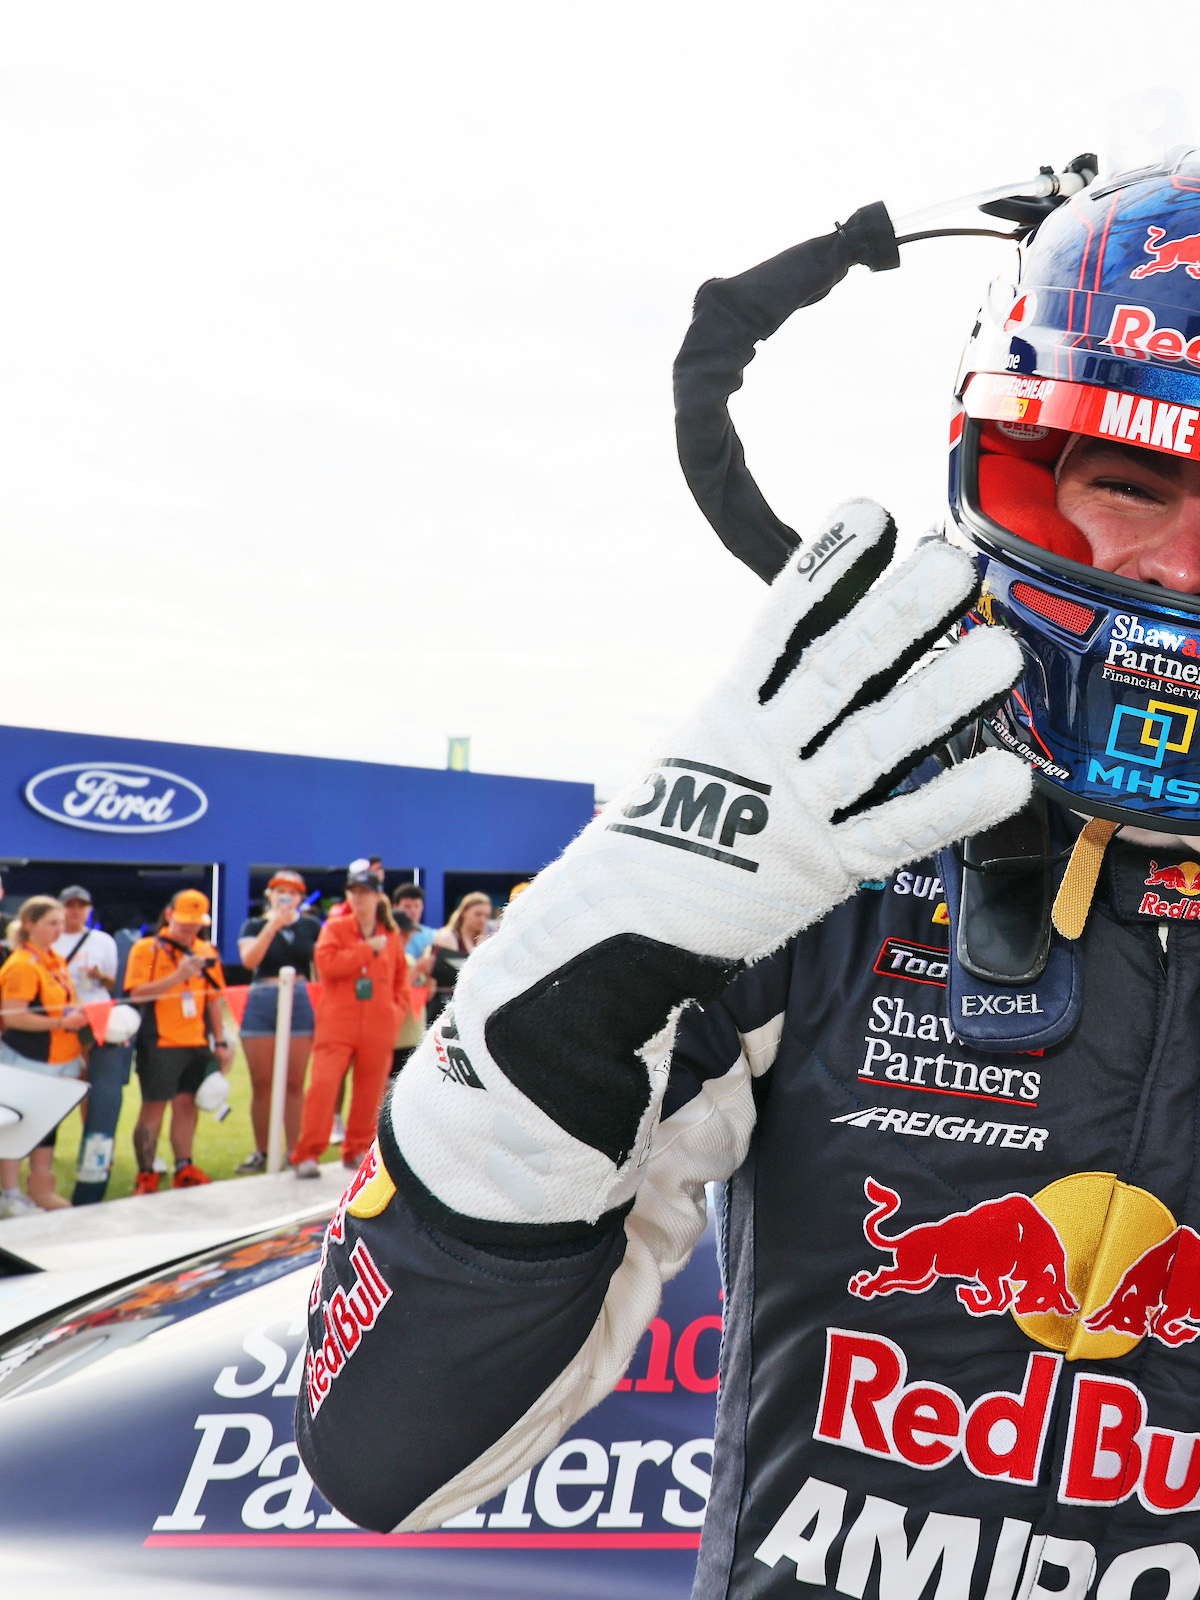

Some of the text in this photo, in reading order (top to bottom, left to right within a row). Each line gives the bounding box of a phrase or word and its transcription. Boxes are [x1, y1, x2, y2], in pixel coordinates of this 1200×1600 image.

[1099, 391, 1196, 454] MAKE
[797, 521, 845, 574] OMP
[1102, 668, 1162, 692] Financial
[62, 769, 176, 823] Ford
[1087, 758, 1200, 805] MHS
[620, 772, 769, 848] OMP
[1138, 892, 1190, 919] Red
[961, 993, 1044, 1018] EXGEL
[857, 1038, 1042, 1101] Partners
[830, 1107, 1049, 1151] FREIGHTER
[329, 1237, 394, 1359] Bull
[813, 1326, 1063, 1486] Red
